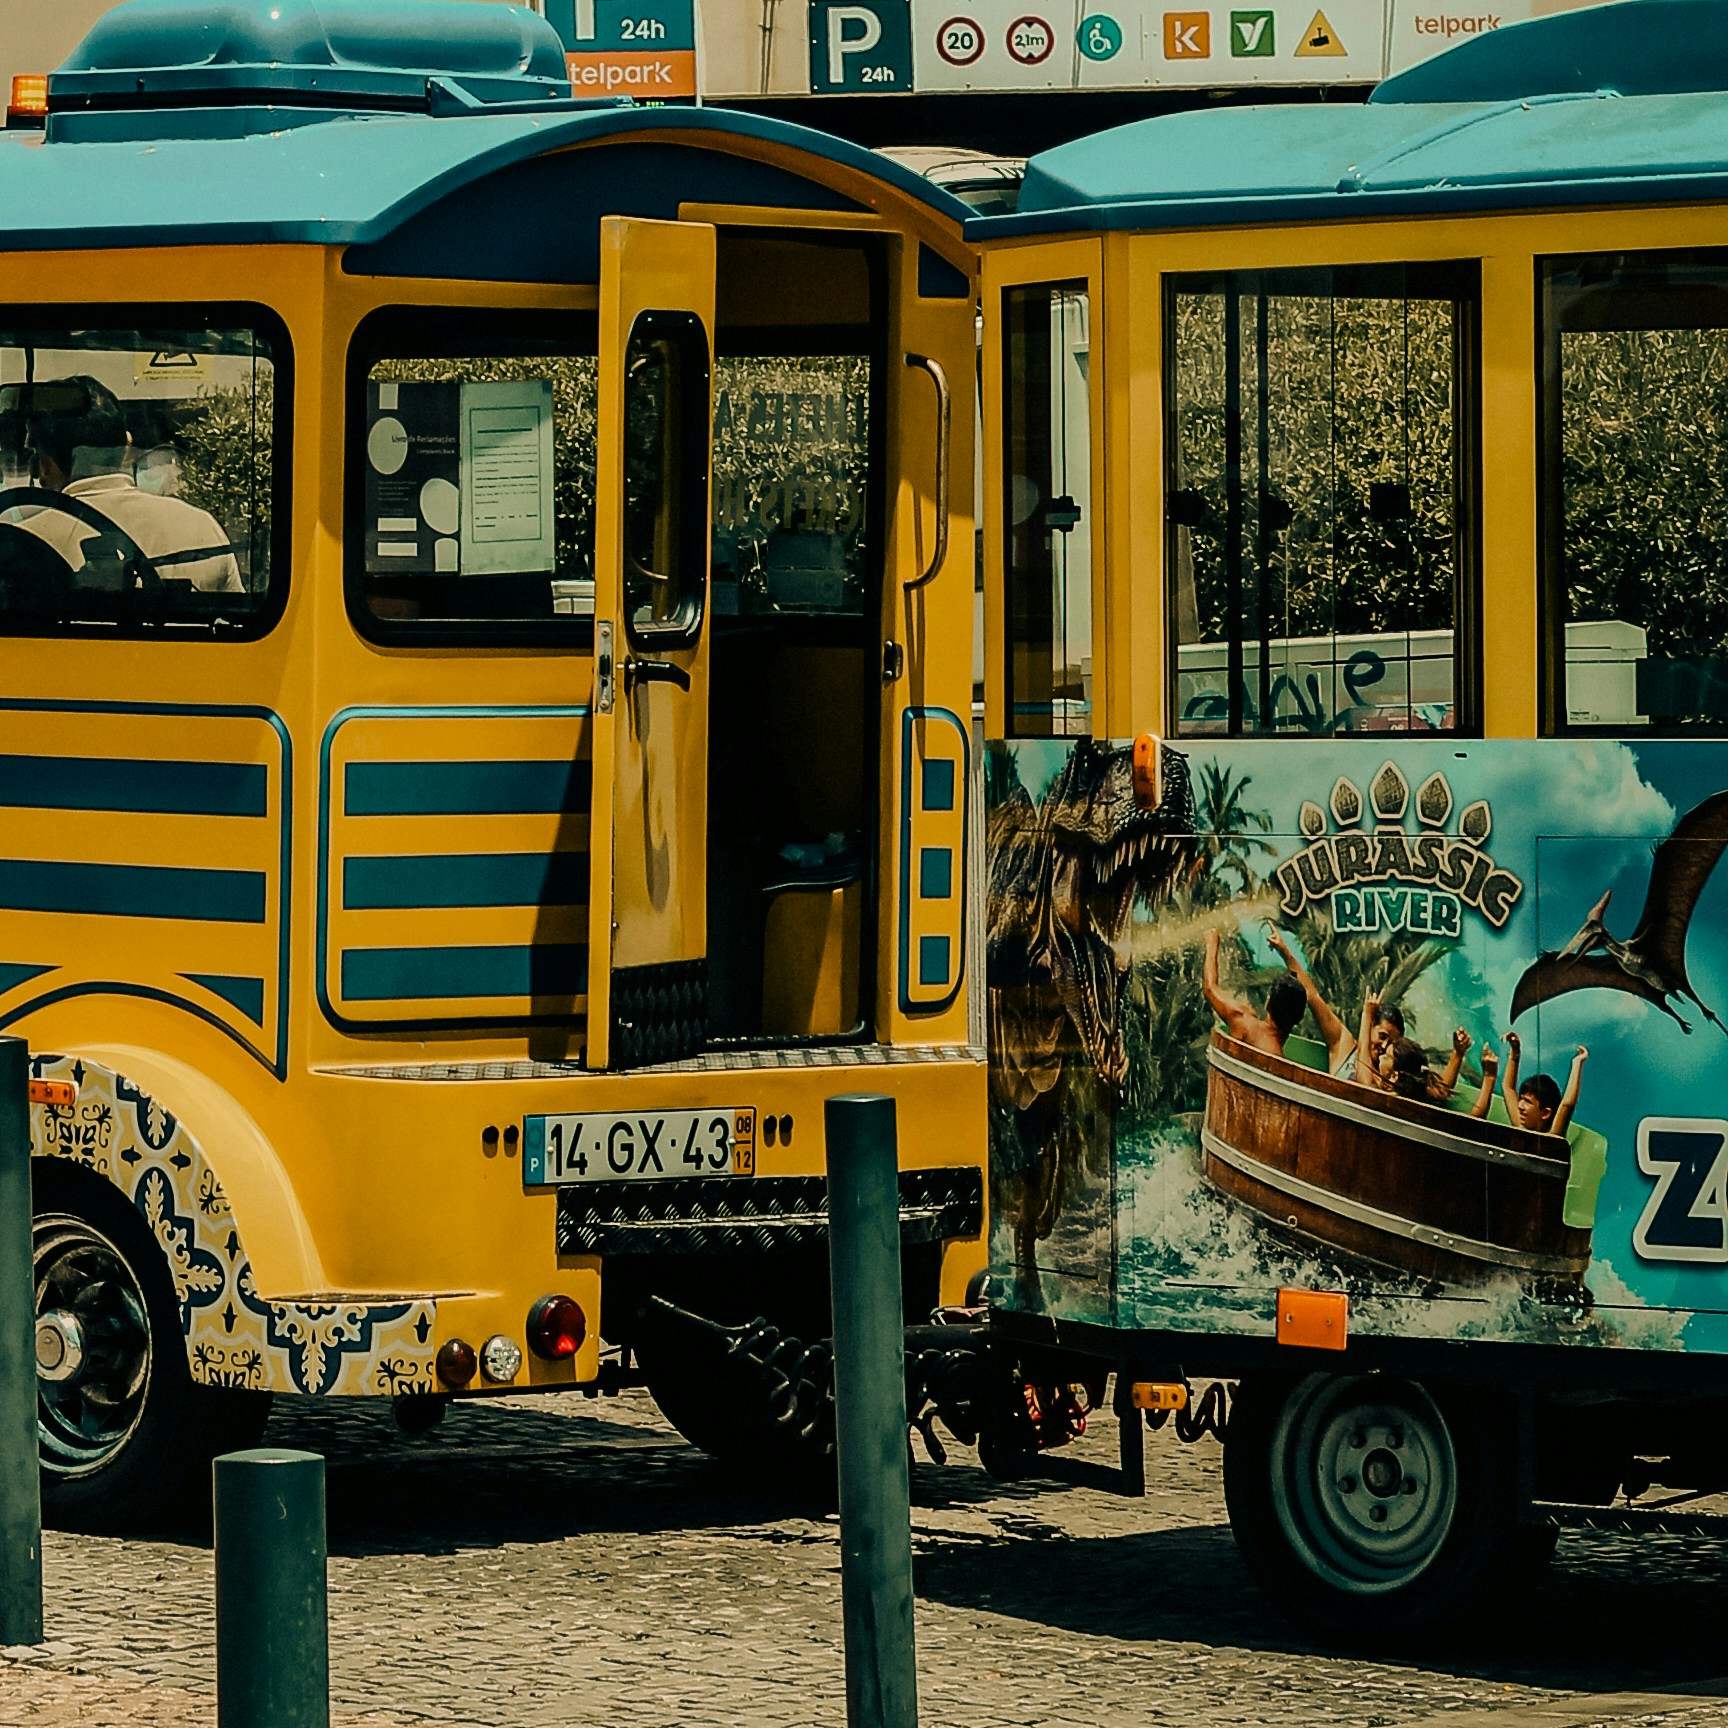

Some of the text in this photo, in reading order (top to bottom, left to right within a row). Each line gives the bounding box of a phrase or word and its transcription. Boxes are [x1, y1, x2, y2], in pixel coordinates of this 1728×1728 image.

[621, 19, 665, 39] 24h
[1415, 14, 1501, 38] telpark
[827, 6, 881, 83] P
[947, 32, 973, 50] 20
[569, 61, 672, 90] telpark
[862, 66, 895, 83] 24h
[1277, 825, 1522, 927] JURASSIC
[1331, 886, 1462, 937] RIVER
[736, 1116, 752, 1133] 08
[530, 1157, 539, 1172] P
[736, 1151, 751, 1169] 12
[1633, 1117, 1728, 1262] Z
